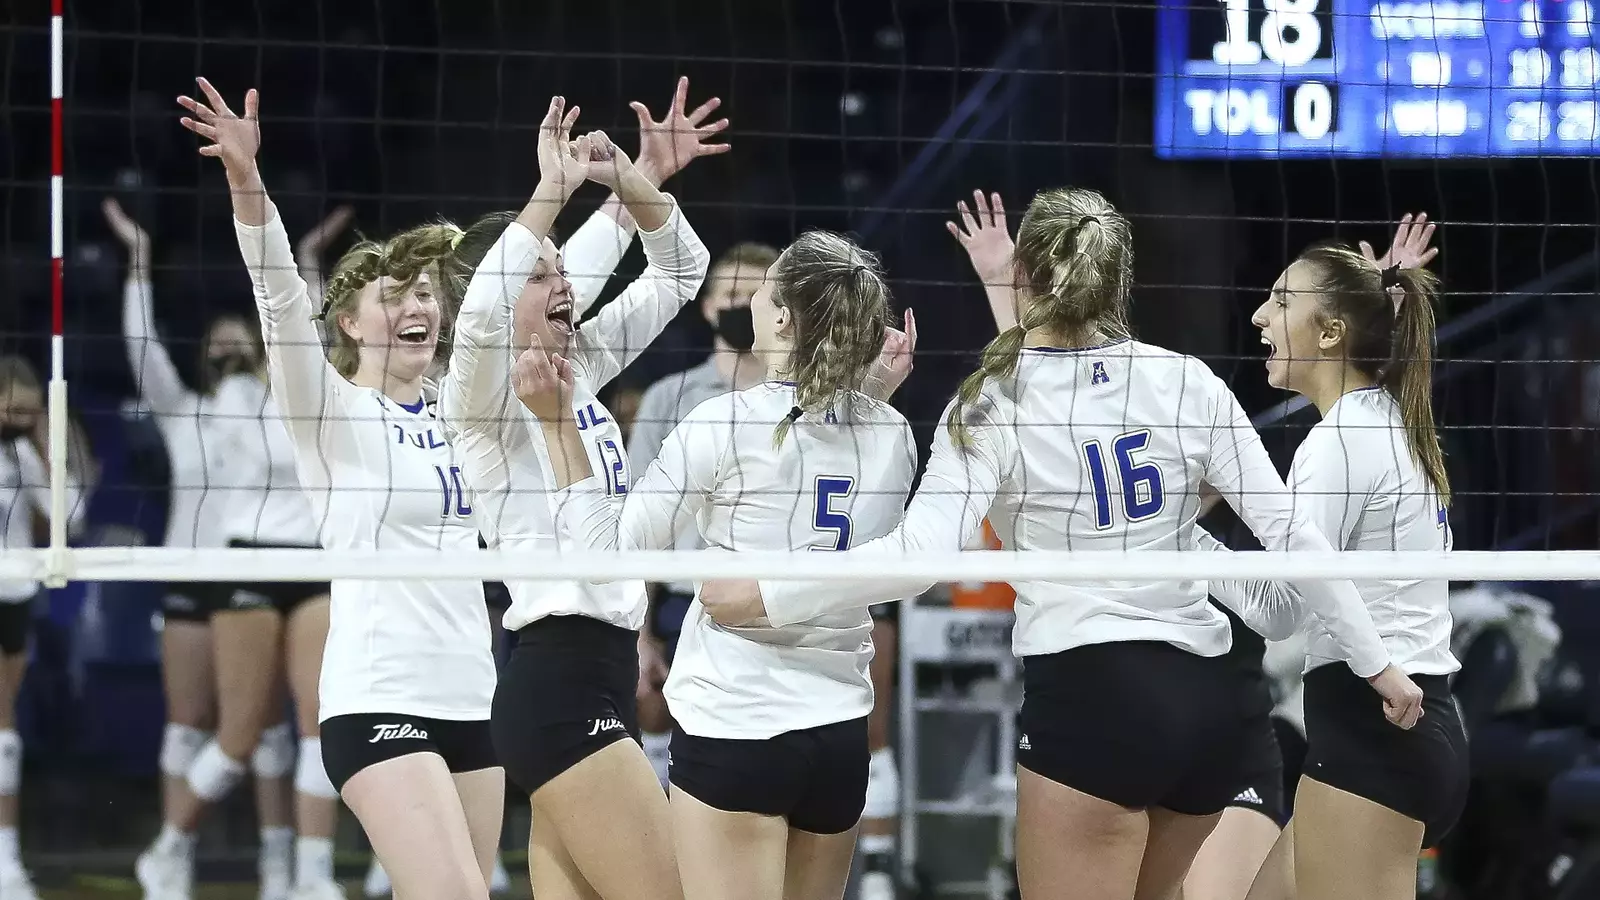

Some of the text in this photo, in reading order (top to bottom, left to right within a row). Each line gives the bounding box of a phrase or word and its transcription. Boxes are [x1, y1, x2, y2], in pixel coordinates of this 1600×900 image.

[1212, 0, 1321, 66] 18
[1185, 89, 1277, 136] TOL
[1293, 81, 1332, 139] 0
[596, 437, 627, 496] 12
[1083, 430, 1165, 530] 16
[810, 476, 854, 552] 5
[369, 723, 428, 743] Tulsa
